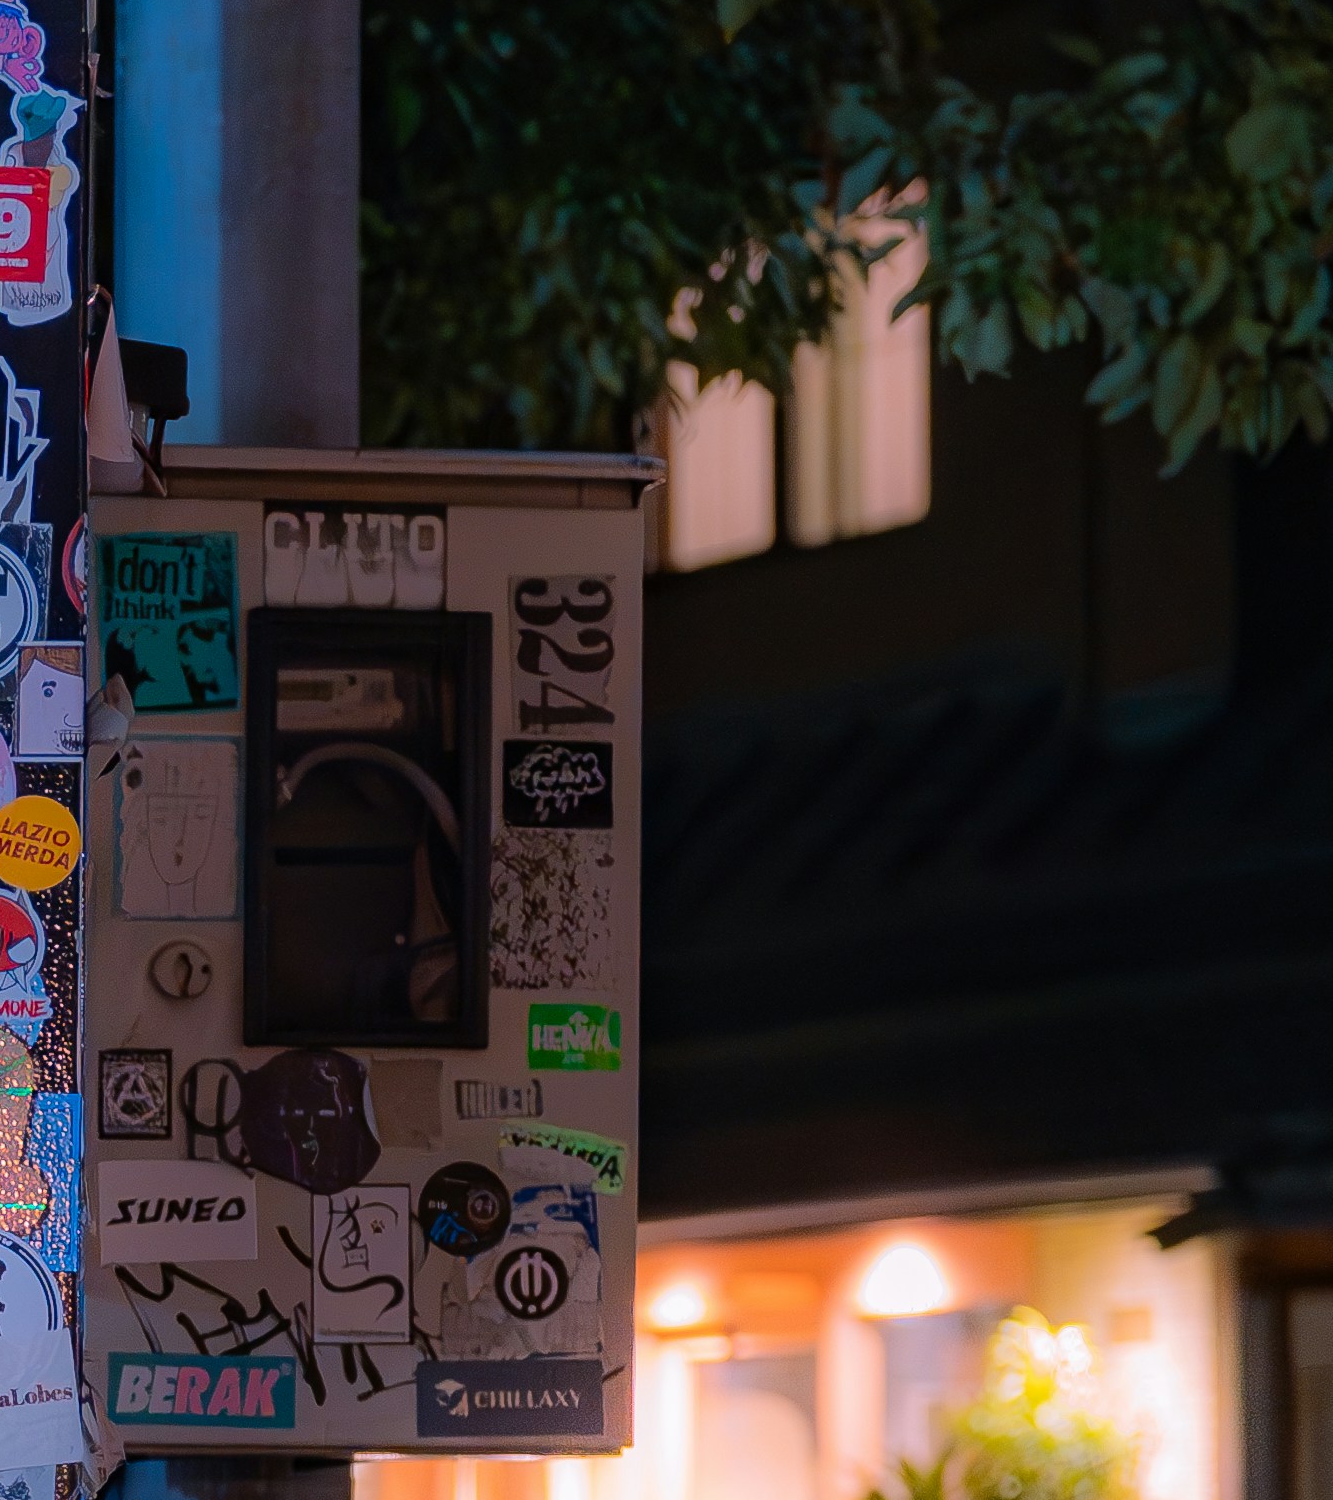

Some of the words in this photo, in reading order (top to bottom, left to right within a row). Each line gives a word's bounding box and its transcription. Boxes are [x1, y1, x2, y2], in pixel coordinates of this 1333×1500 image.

[514, 577, 617, 732] 324
[0, 816, 71, 848] LAZIO
[115, 1365, 283, 1418] BERAK
[474, 1388, 582, 1410] CHILLAXY
